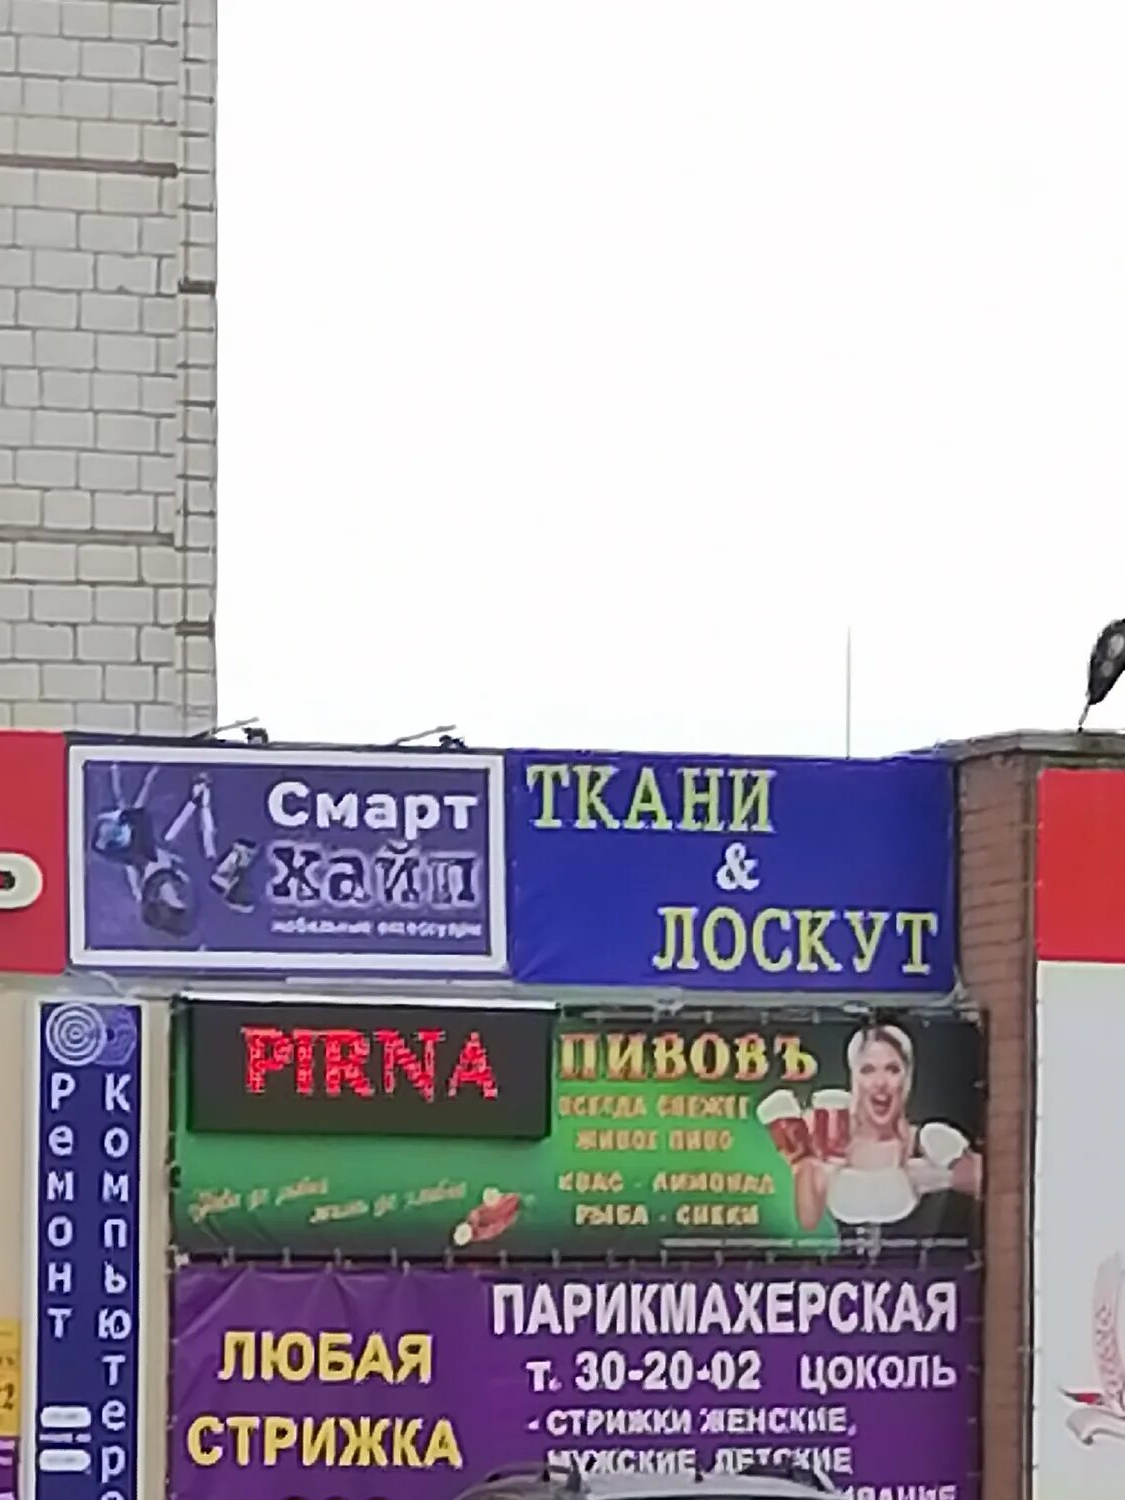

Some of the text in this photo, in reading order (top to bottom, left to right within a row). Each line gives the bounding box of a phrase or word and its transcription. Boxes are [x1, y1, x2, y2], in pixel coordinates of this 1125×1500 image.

[268, 780, 479, 840] Смарт
[525, 764, 776, 833] ТКАНИ
[267, 840, 482, 909] Хайп
[715, 841, 761, 891] &
[652, 906, 938, 975] ЛОСКУТ
[241, 1024, 499, 1102] PIRNA
[559, 1031, 818, 1083] ПИВОВЪ
[46, 1071, 76, 1340] Ремонт
[491, 1281, 959, 1336] ПАРИКМАХЕРСКАЯ
[217, 1330, 434, 1385] ЛЮБАЯ
[575, 1350, 763, 1391] 30-20-02
[187, 1416, 464, 1469] СТРИЖКА
[546, 1408, 692, 1437] СТРИЖКИ
